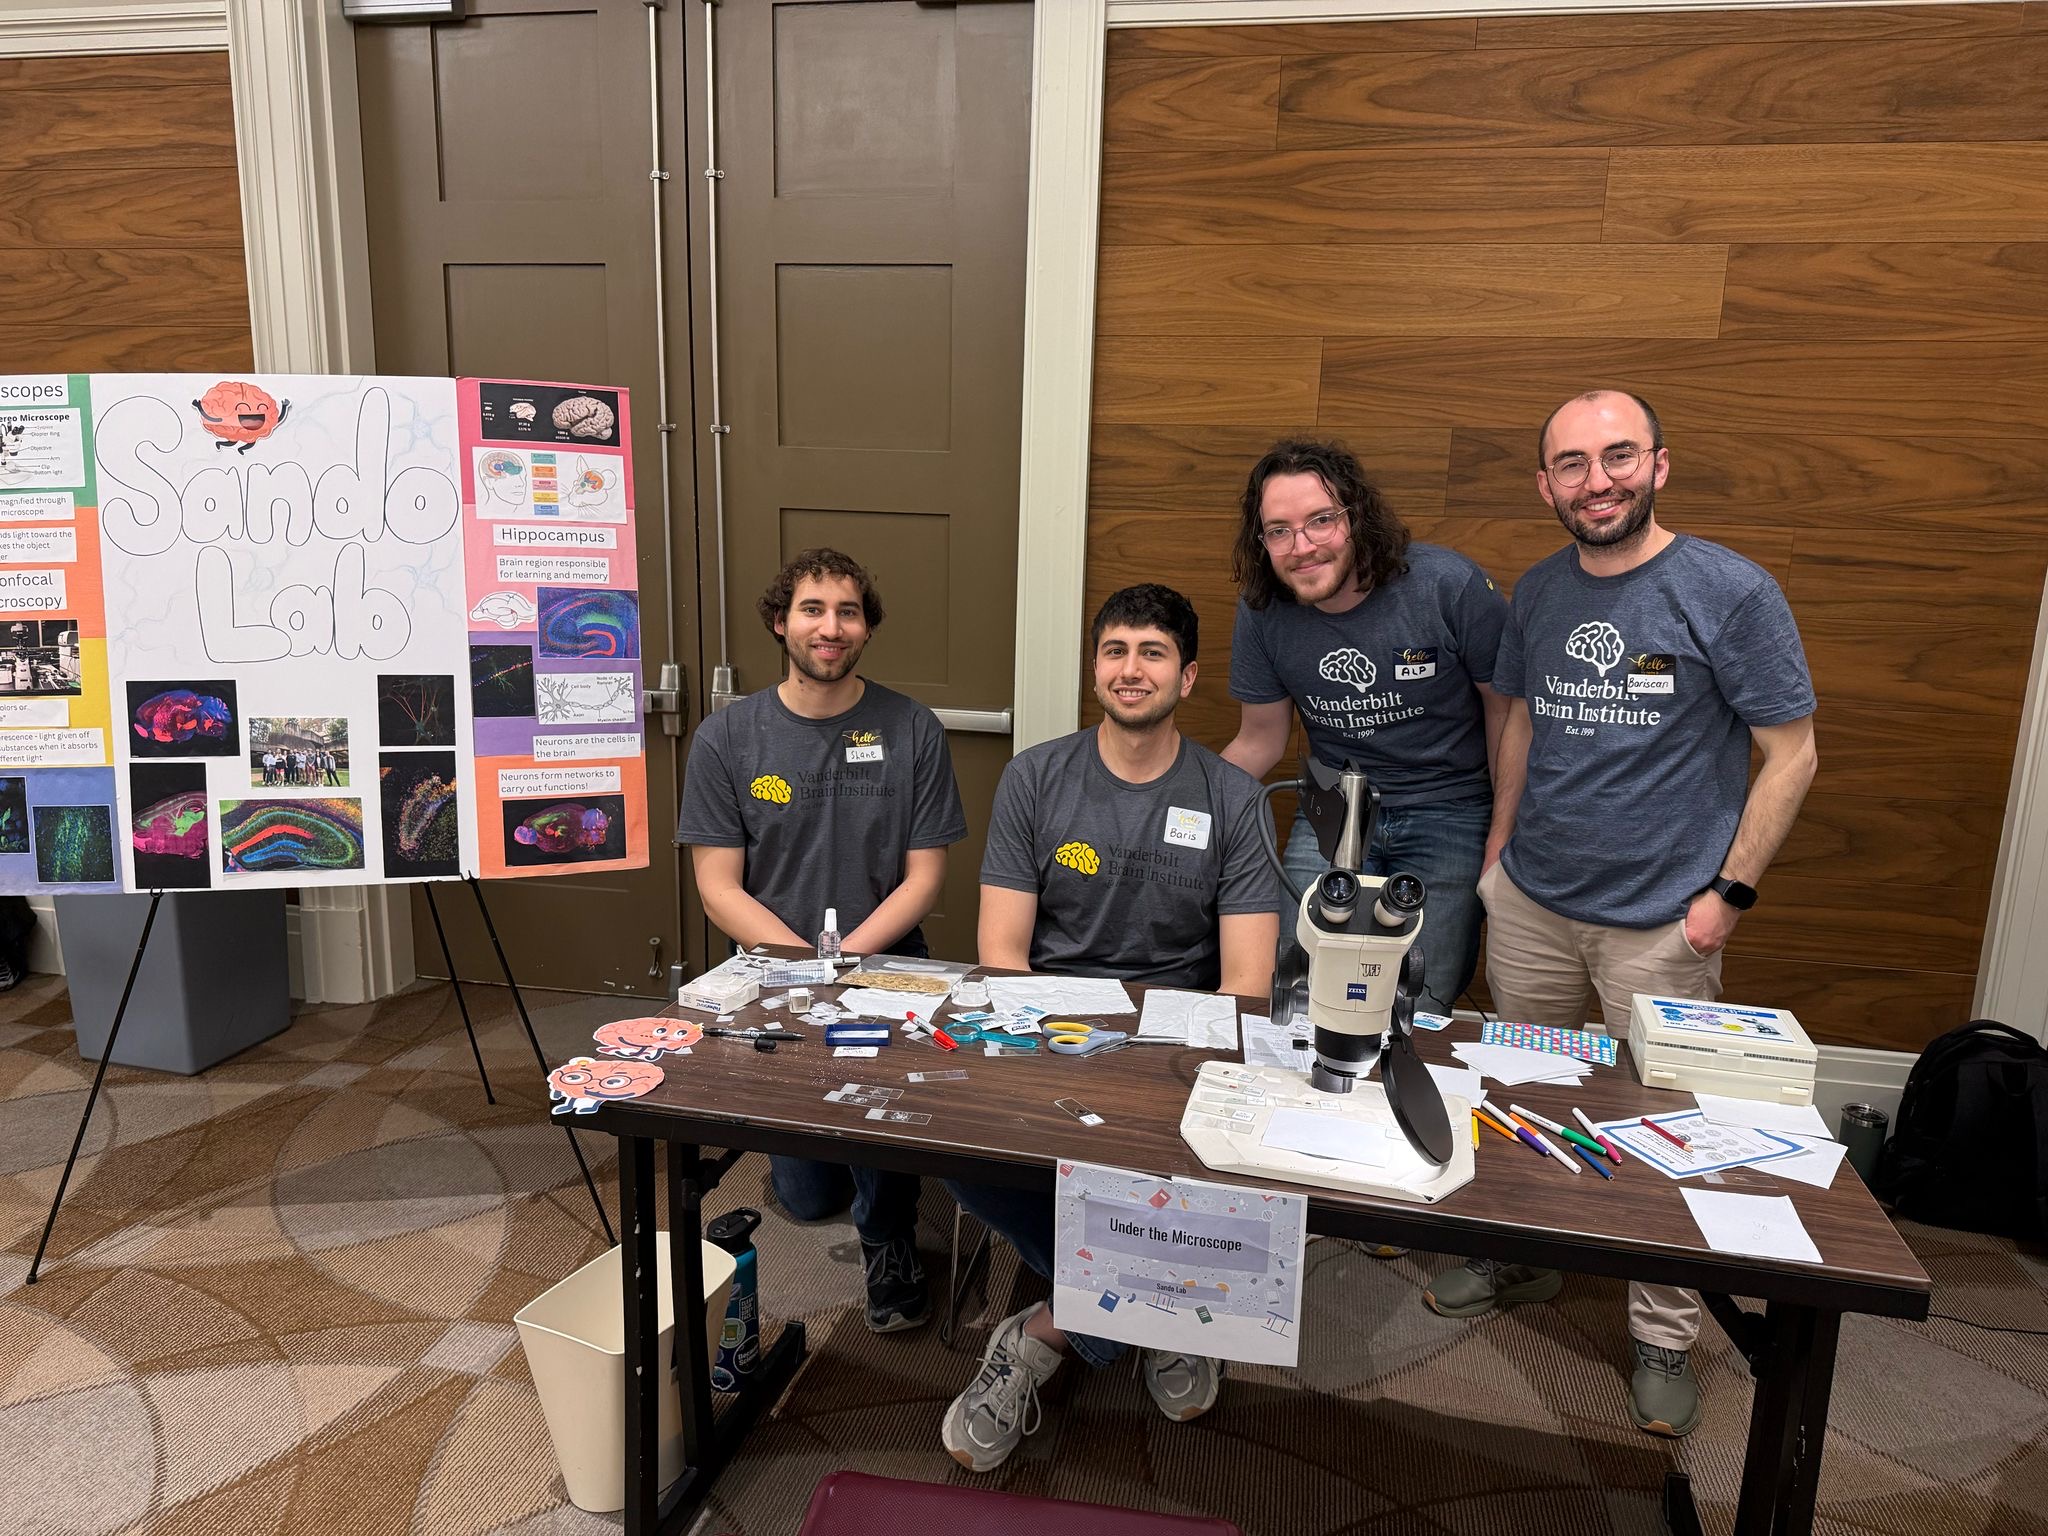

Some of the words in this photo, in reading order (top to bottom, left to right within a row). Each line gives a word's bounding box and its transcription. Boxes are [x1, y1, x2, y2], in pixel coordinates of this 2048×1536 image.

[20, 413, 70, 422] Microscope
[95, 386, 460, 557] Sando
[36, 496, 66, 505] through
[1, 508, 44, 517] microscope
[13, 531, 29, 541] light
[31, 531, 57, 539] toward
[59, 530, 72, 538] the
[501, 527, 606, 545] Hippocampus
[12, 542, 24, 550] the
[27, 541, 50, 551] object
[499, 558, 523, 566] Brain
[525, 558, 553, 568] region
[556, 559, 606, 568] responsible
[499, 570, 513, 578] for
[515, 570, 552, 580] learning
[554, 570, 570, 579] and
[572, 573, 608, 581] memory
[195, 541, 411, 664] Lab
[1401, 665, 1427, 677] ALP
[1545, 675, 1639, 701] Vanderbi
[1306, 691, 1404, 712] Vanderbilt
[1535, 696, 1573, 720] Brain
[1576, 701, 1661, 725] Institute
[1301, 706, 1345, 729] Brain
[1347, 705, 1425, 729] Institute
[39, 732, 56, 741] light
[57, 731, 77, 741] given
[78, 731, 90, 739] off
[1357, 728, 1375, 739] 1999
[1564, 725, 1580, 736] Est.
[535, 738, 573, 746] Neurons
[575, 737, 589, 745] are
[591, 736, 605, 744] the
[607, 735, 625, 743] cells
[627, 734, 636, 742] in
[847, 730, 879, 744] hello
[67, 742, 98, 750] absorbs
[26, 754, 43, 763] light
[536, 750, 551, 758] the
[553, 749, 576, 757] brain
[850, 750, 877, 760] Shane
[500, 773, 539, 781] Neurons
[541, 771, 563, 779] form
[564, 769, 604, 779] networks
[605, 769, 615, 777] to
[797, 767, 871, 784] Vanderbilt
[501, 785, 525, 794] carry
[543, 782, 588, 792] functions!
[799, 783, 836, 800] Brain
[839, 785, 896, 798] Institute
[1169, 827, 1197, 841] Baris
[1107, 844, 1180, 868] Vanderbilt
[1108, 860, 1145, 878] Brain
[1147, 866, 1205, 890] Institute
[1109, 1217, 1145, 1237] Under
[1148, 1226, 1168, 1242] the
[1171, 1229, 1242, 1253] Microscope
[1156, 1282, 1175, 1293] Sando
[1176, 1284, 1187, 1294] Lab
